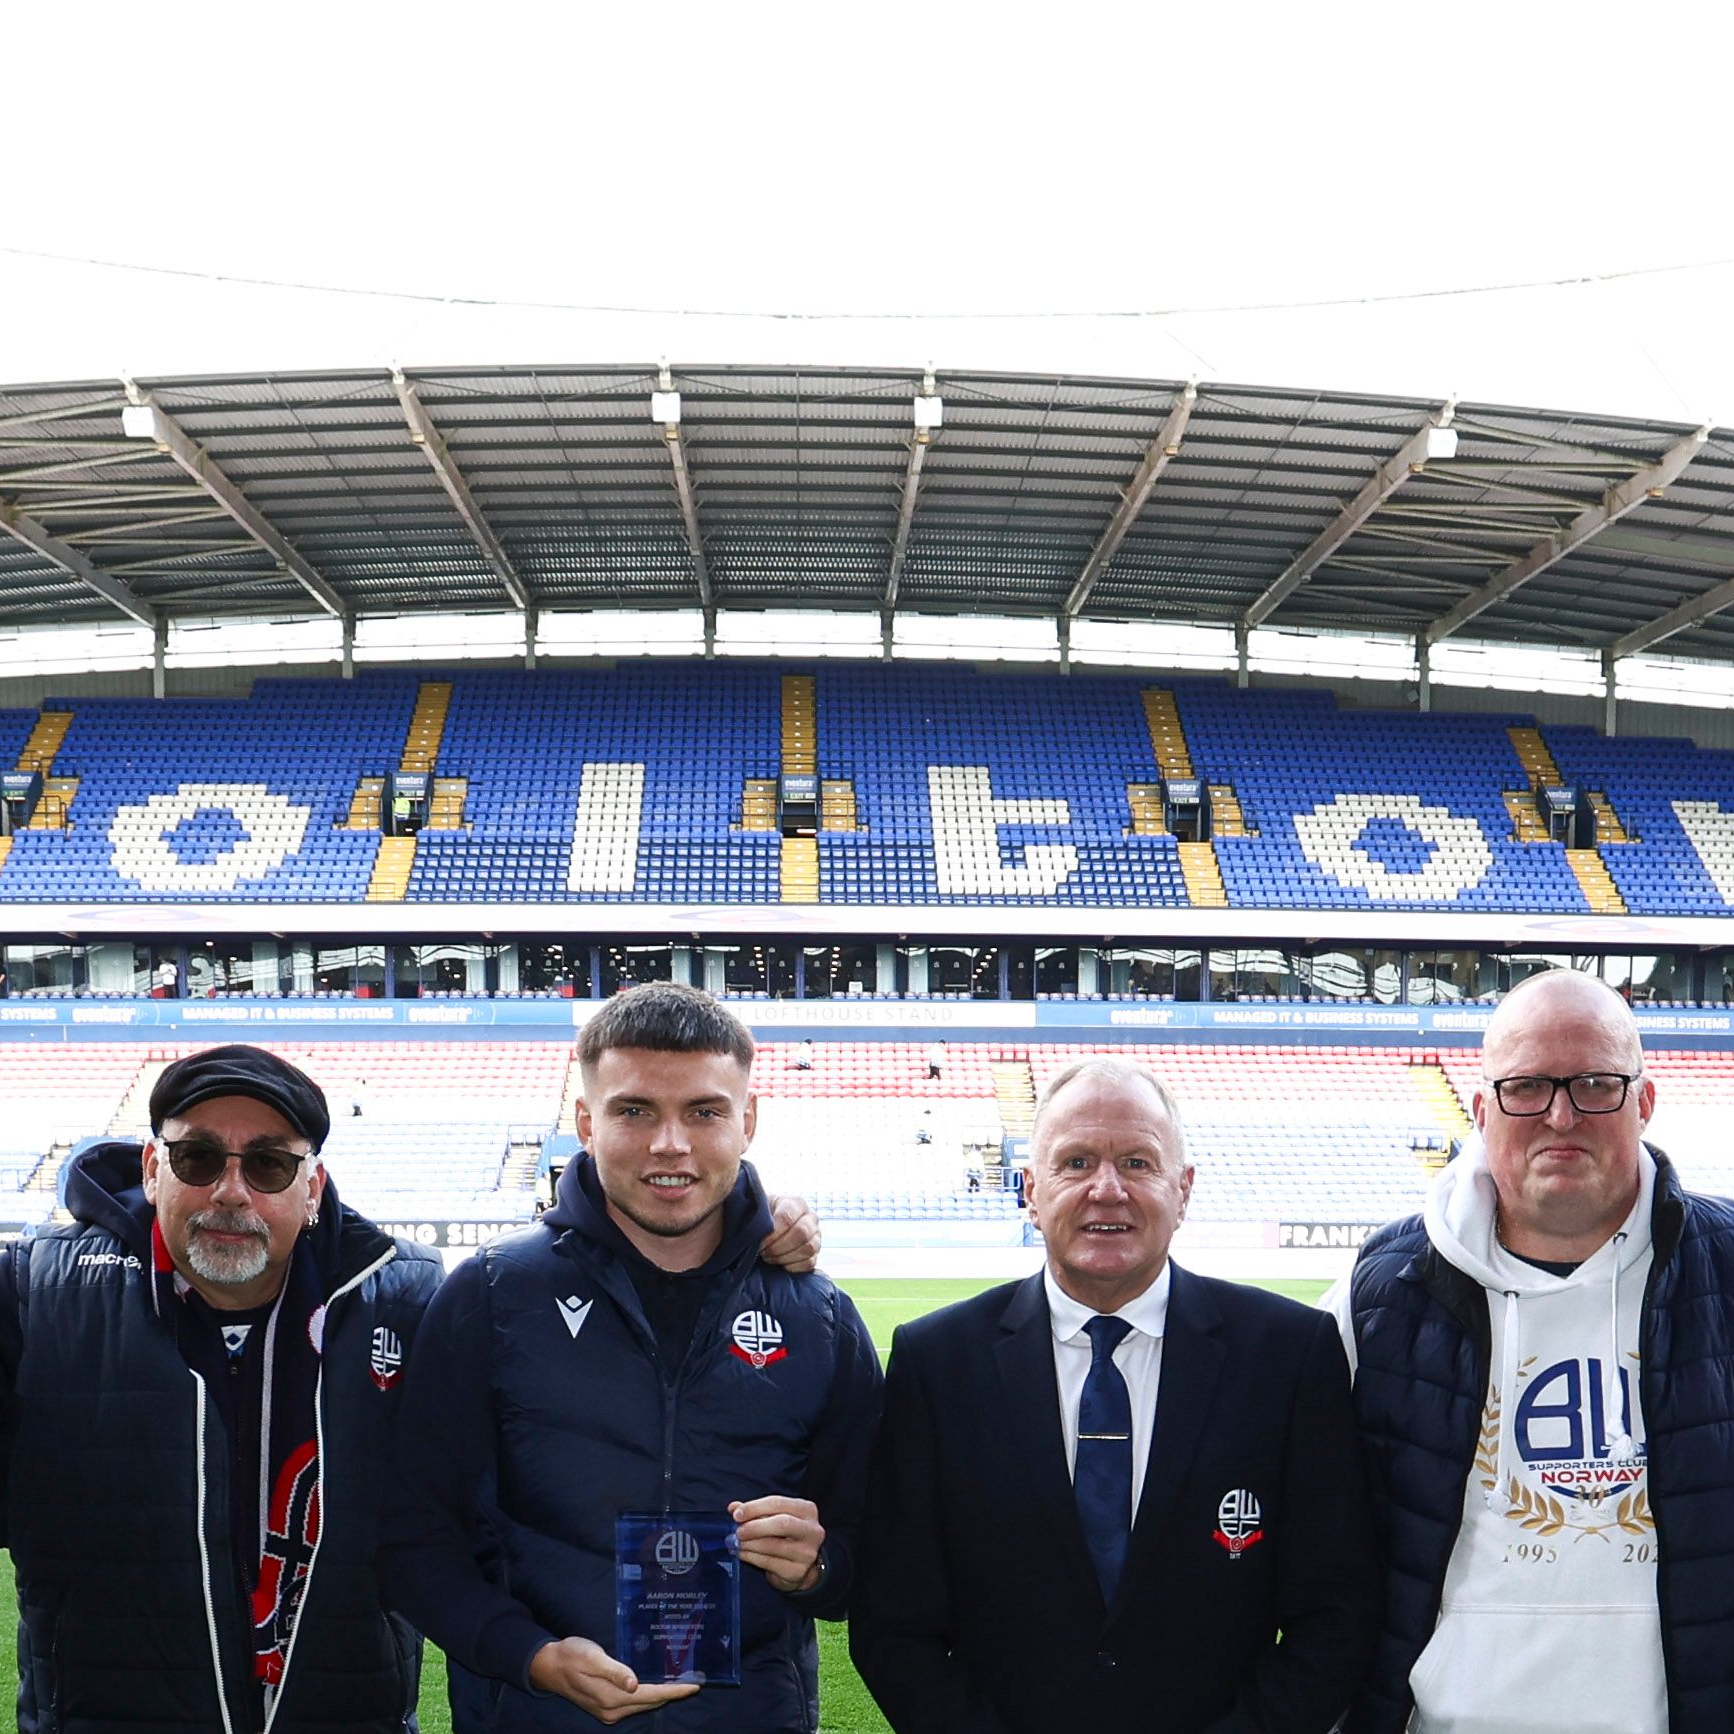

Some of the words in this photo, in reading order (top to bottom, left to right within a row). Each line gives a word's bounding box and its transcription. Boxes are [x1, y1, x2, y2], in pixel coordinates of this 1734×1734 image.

[1, 1009, 57, 1020] SYSTEMS
[182, 1007, 248, 1019] MANAGED
[250, 1007, 263, 1019] IT
[265, 1007, 275, 1019] &
[277, 1007, 336, 1019] BUSINESS
[338, 1007, 394, 1019] SYSTEMS
[754, 1007, 874, 1021] LOFTHOUSE
[884, 1007, 953, 1021] STAND
[1110, 1007, 1168, 1024] eventura
[1214, 1011, 1276, 1022] MANAGED
[1278, 1011, 1292, 1023] IT
[1293, 1012, 1303, 1023] &
[1305, 1012, 1364, 1024] BUSINESS
[1365, 1013, 1419, 1025] SYSTEMS
[1678, 1017, 1731, 1029] SYSTEMS
[1528, 1460, 1614, 1471] SUPPORTERS
[1541, 1468, 1644, 1485] NORWAY
[1502, 1544, 1558, 1563] 1995
